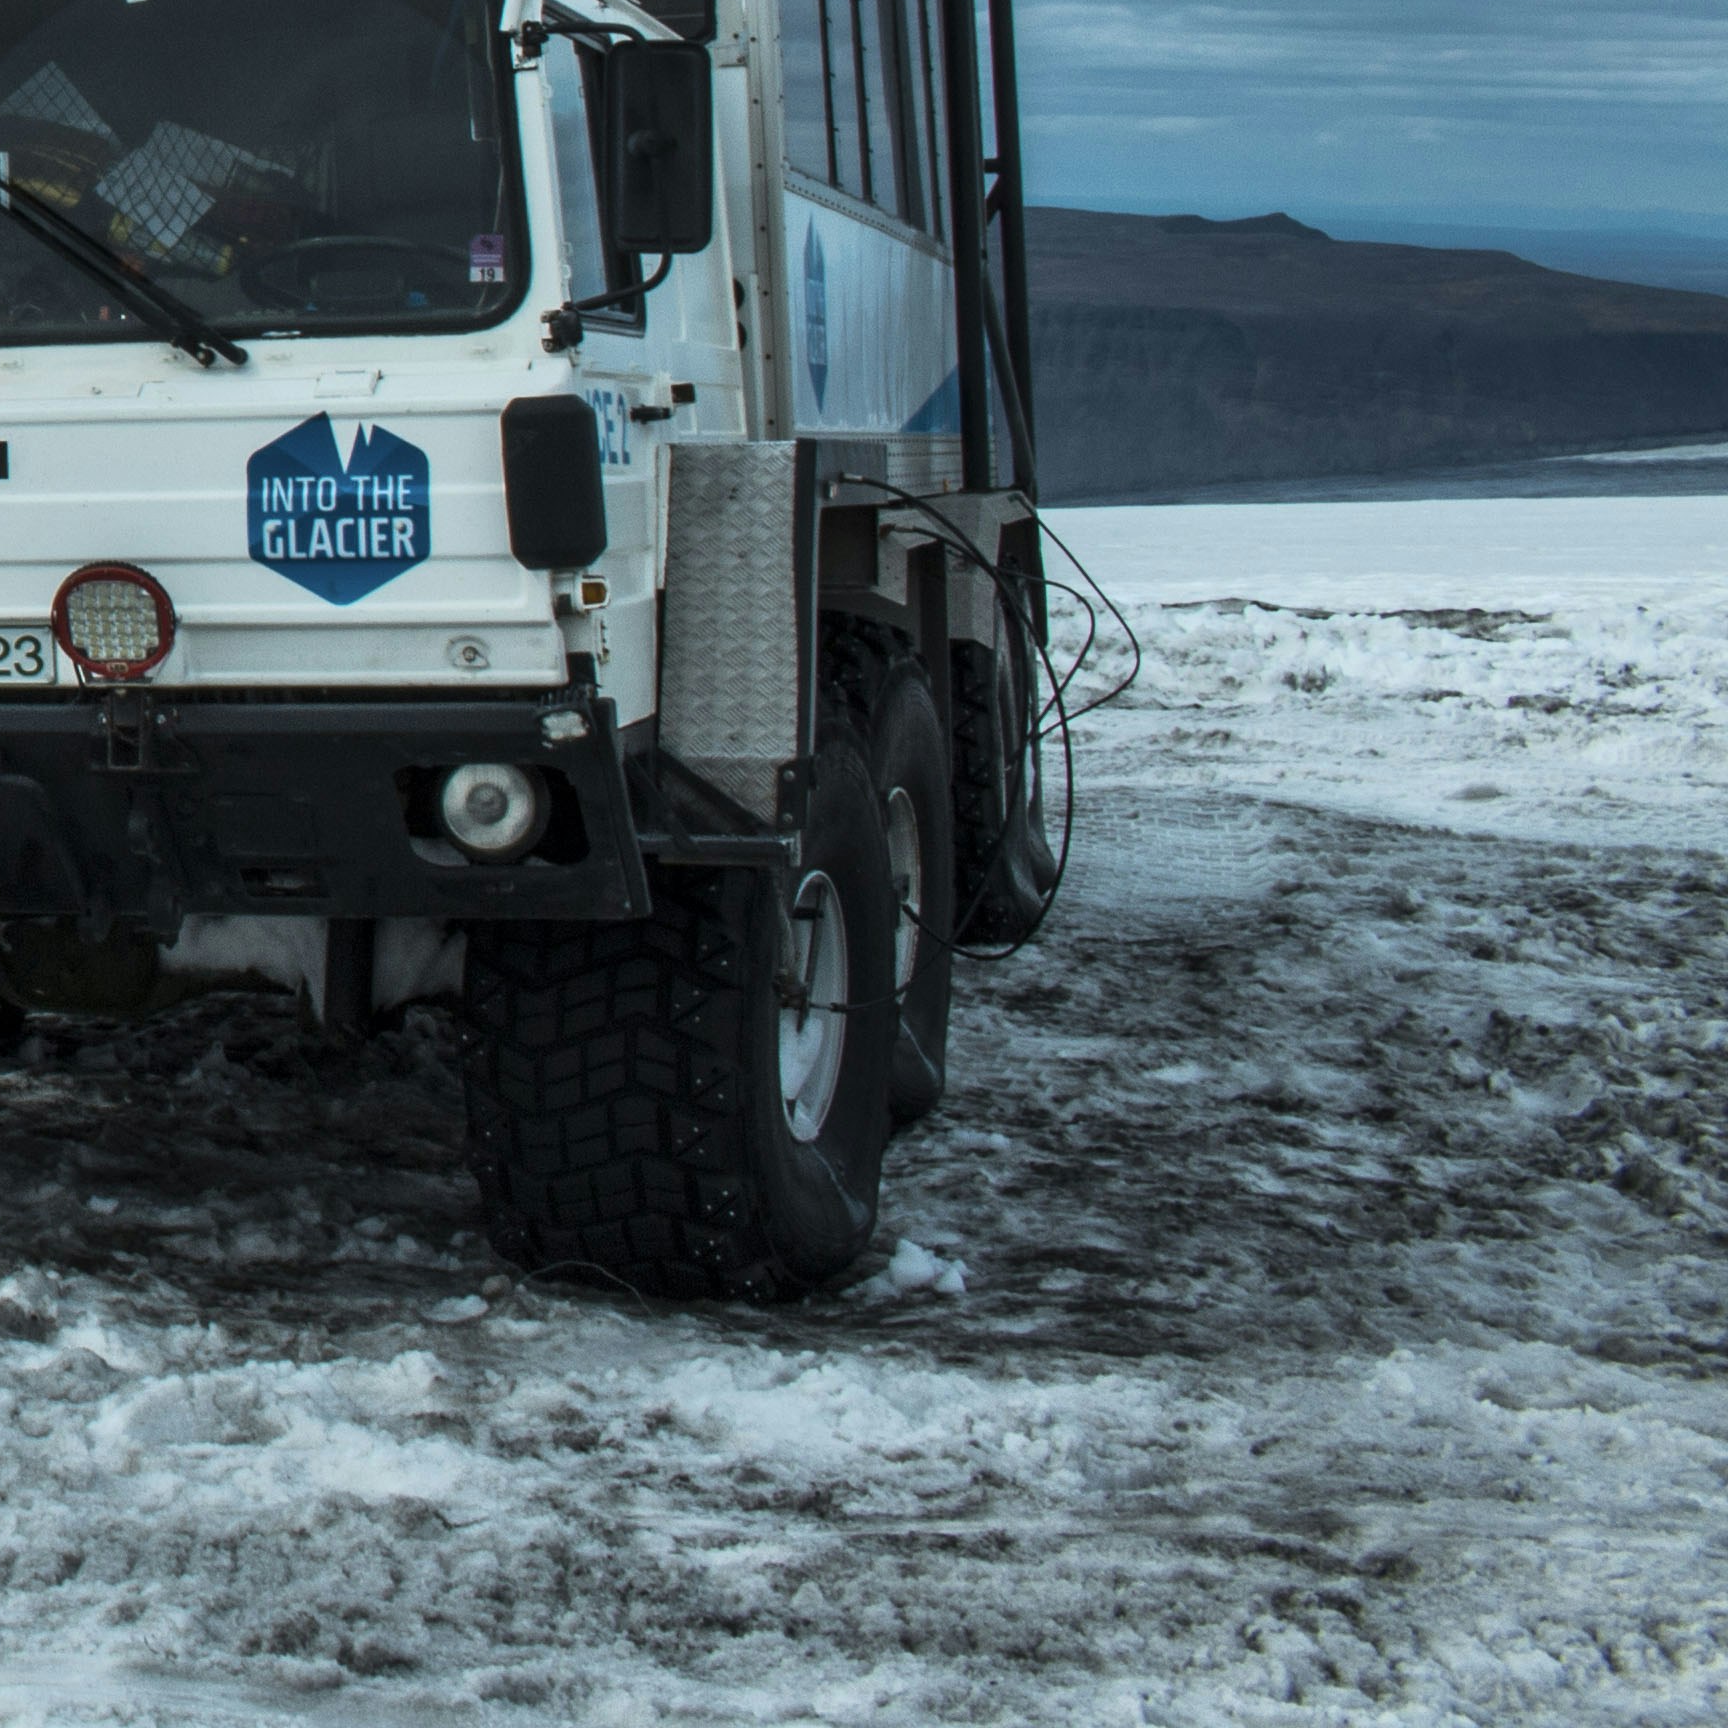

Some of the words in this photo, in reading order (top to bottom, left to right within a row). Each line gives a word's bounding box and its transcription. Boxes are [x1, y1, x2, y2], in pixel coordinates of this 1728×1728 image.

[262, 475, 337, 513] INTO
[350, 474, 414, 511] THE
[262, 516, 416, 560] GLACIER
